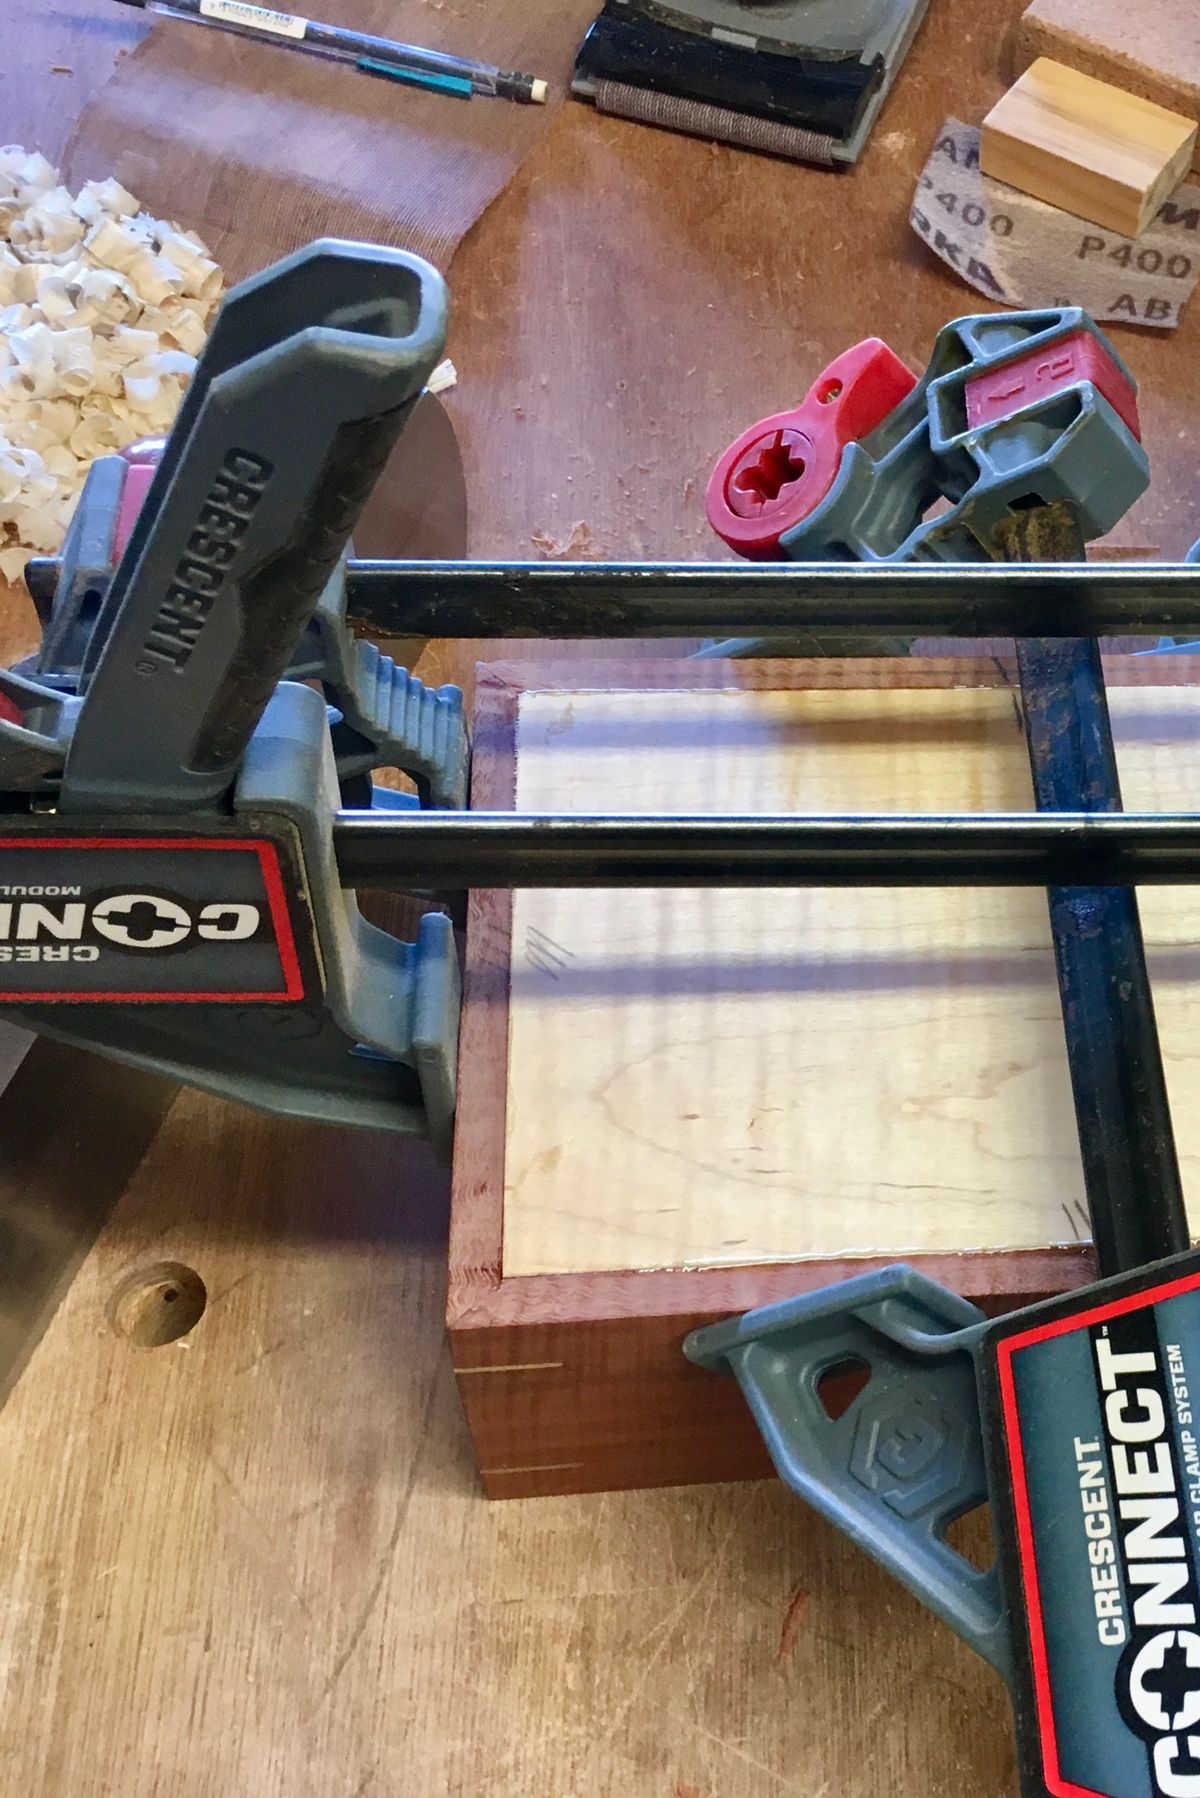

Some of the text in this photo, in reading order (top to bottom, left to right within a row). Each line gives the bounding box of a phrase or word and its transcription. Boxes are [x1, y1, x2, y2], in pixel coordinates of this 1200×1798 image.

[1075, 235, 1192, 279] P400
[1107, 293, 1185, 320] AB
[143, 446, 275, 670] CRESCENT
[0, 894, 260, 948] CON
[1166, 1344, 1192, 1425] SYSTEM
[1074, 1436, 1127, 1646] CRESCENT
